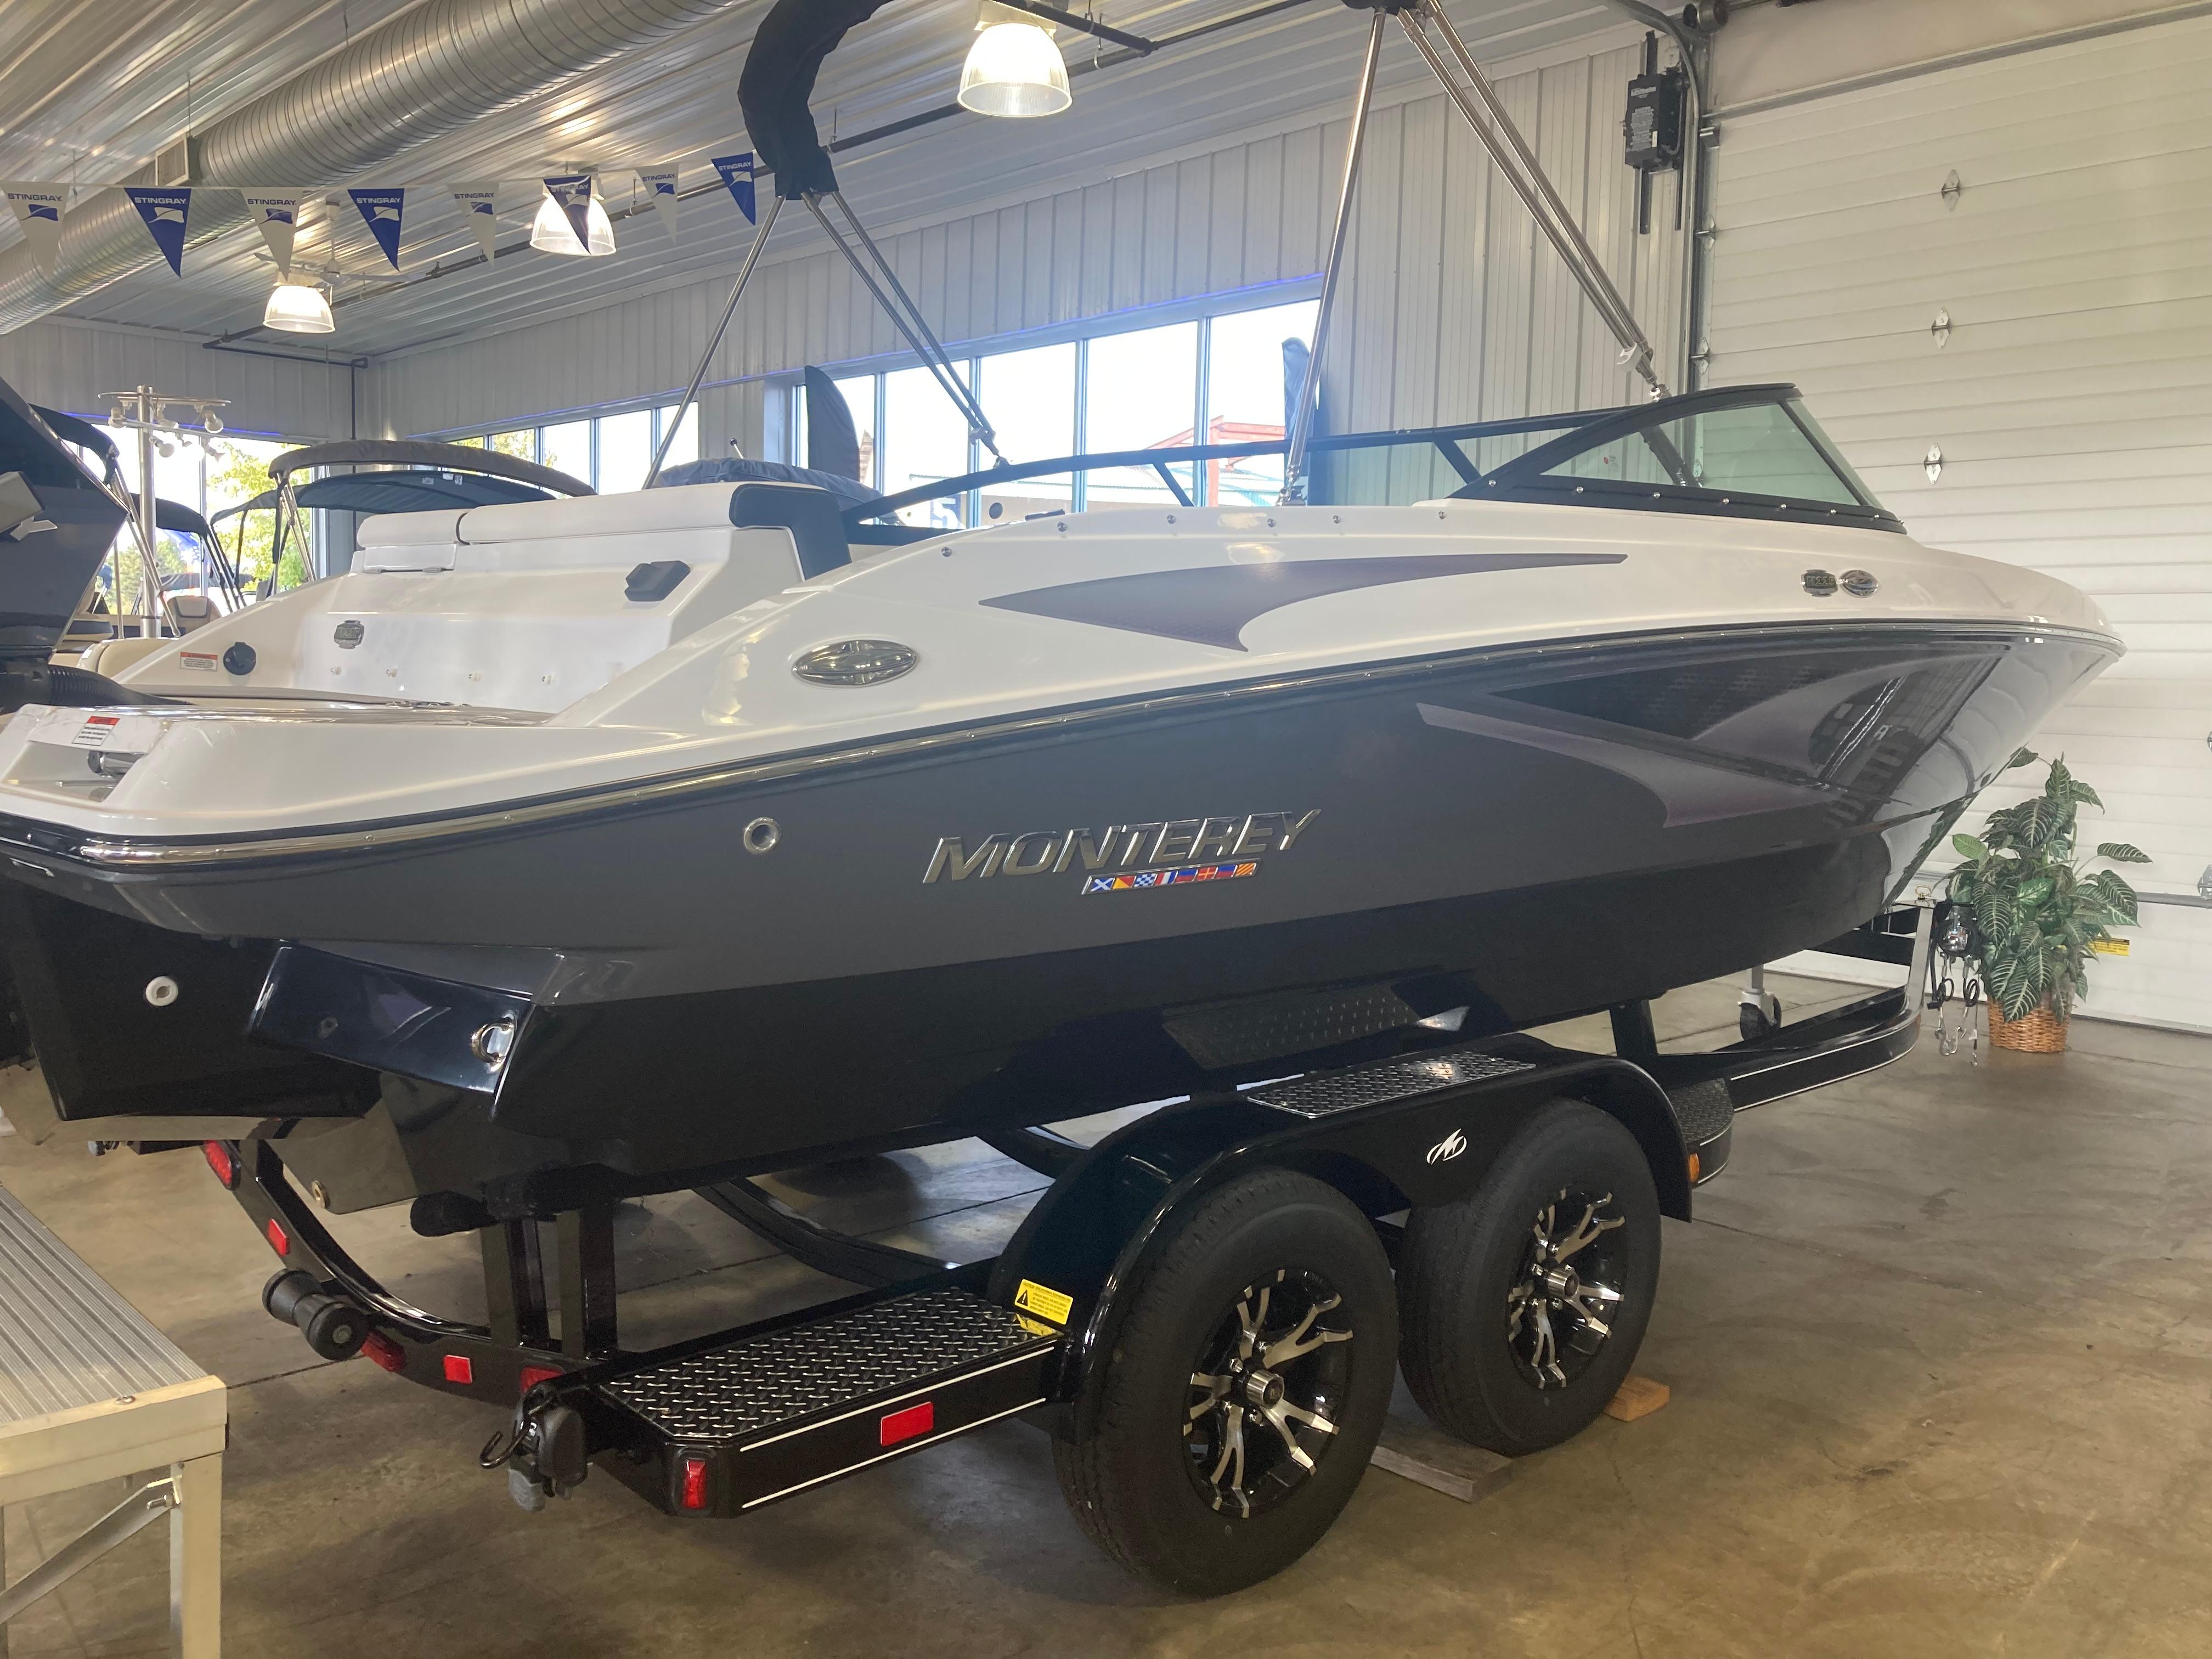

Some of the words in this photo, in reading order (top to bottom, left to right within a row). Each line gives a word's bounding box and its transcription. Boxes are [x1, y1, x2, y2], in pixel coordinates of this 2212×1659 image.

[719, 162, 751, 171] STINGRAY
[642, 173, 675, 182] STINGRAY
[923, 809, 1322, 883] MONTEREY
